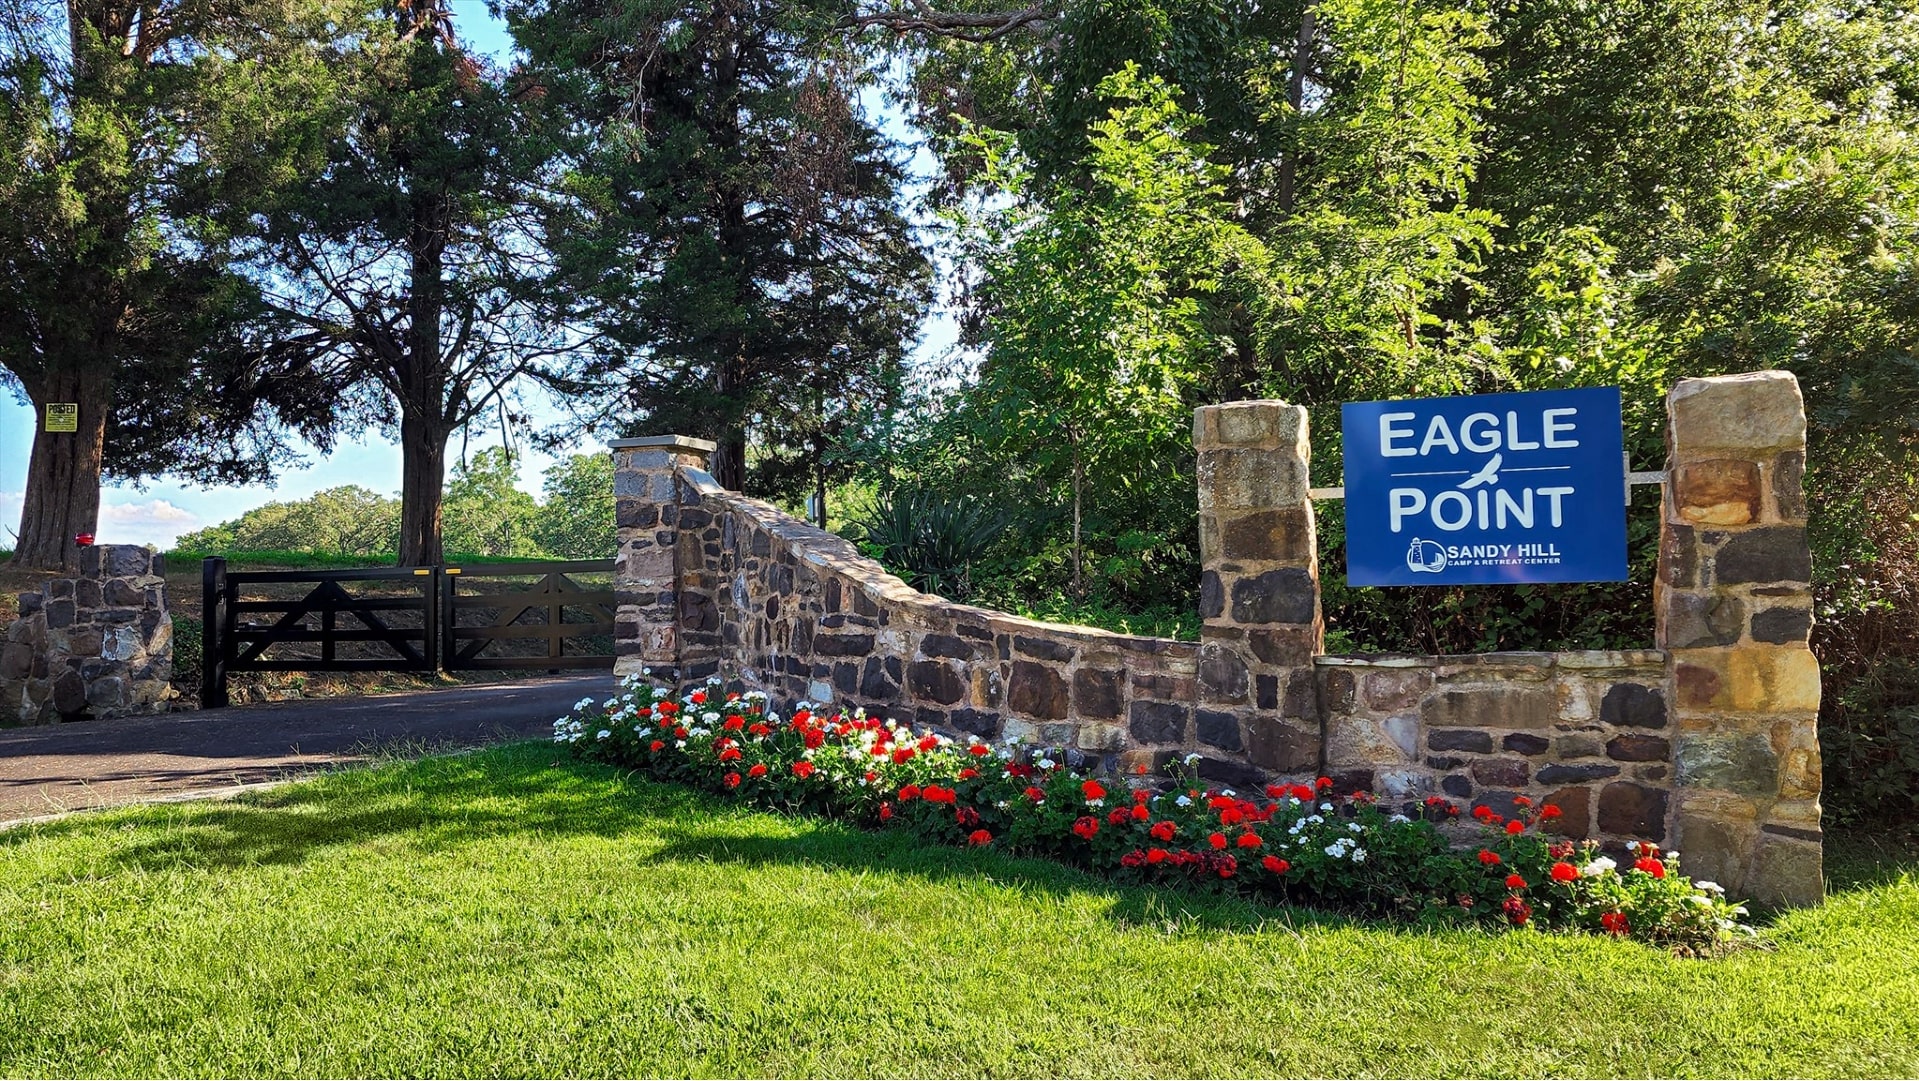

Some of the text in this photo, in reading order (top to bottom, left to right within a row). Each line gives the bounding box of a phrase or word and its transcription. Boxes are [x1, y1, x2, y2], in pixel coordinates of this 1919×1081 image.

[1379, 407, 1580, 458] EAGLE
[1389, 486, 1575, 533] POINT
[1447, 543, 1561, 559] SANDY HILL
